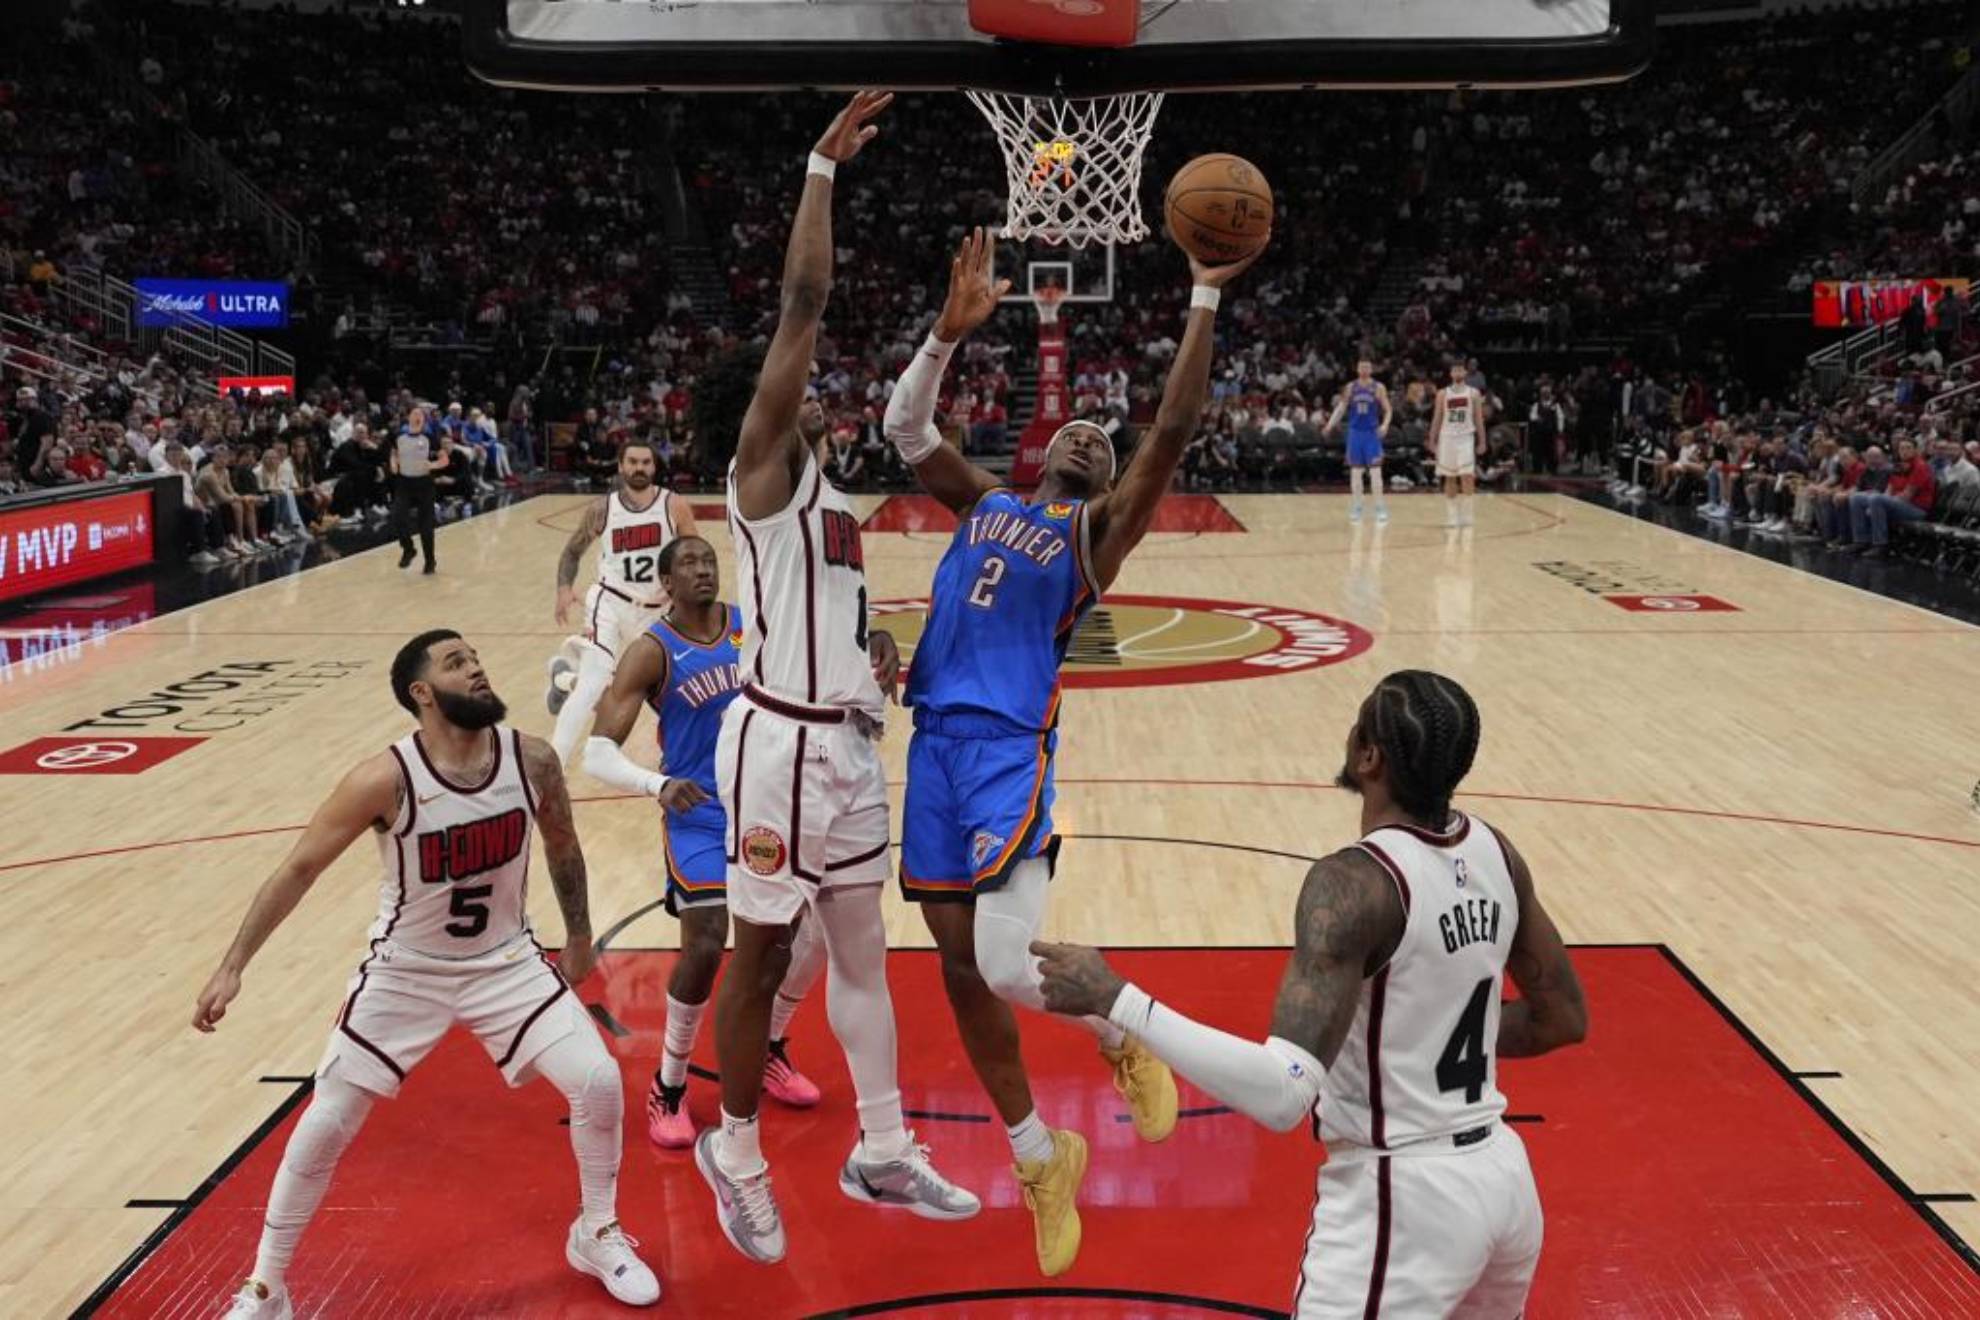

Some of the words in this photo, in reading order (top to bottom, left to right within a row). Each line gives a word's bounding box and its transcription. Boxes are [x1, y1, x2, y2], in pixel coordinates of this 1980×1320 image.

[221, 295, 281, 313] ULTRA
[17, 521, 78, 575] MVP
[622, 556, 654, 584] 12
[969, 556, 1006, 607] 2
[61, 659, 295, 732] TOYOTA
[173, 659, 372, 733] CENTER
[676, 663, 743, 708] THUND
[445, 884, 494, 938] 5
[1438, 897, 1501, 955] GREEN
[1435, 975, 1494, 1105] 4
